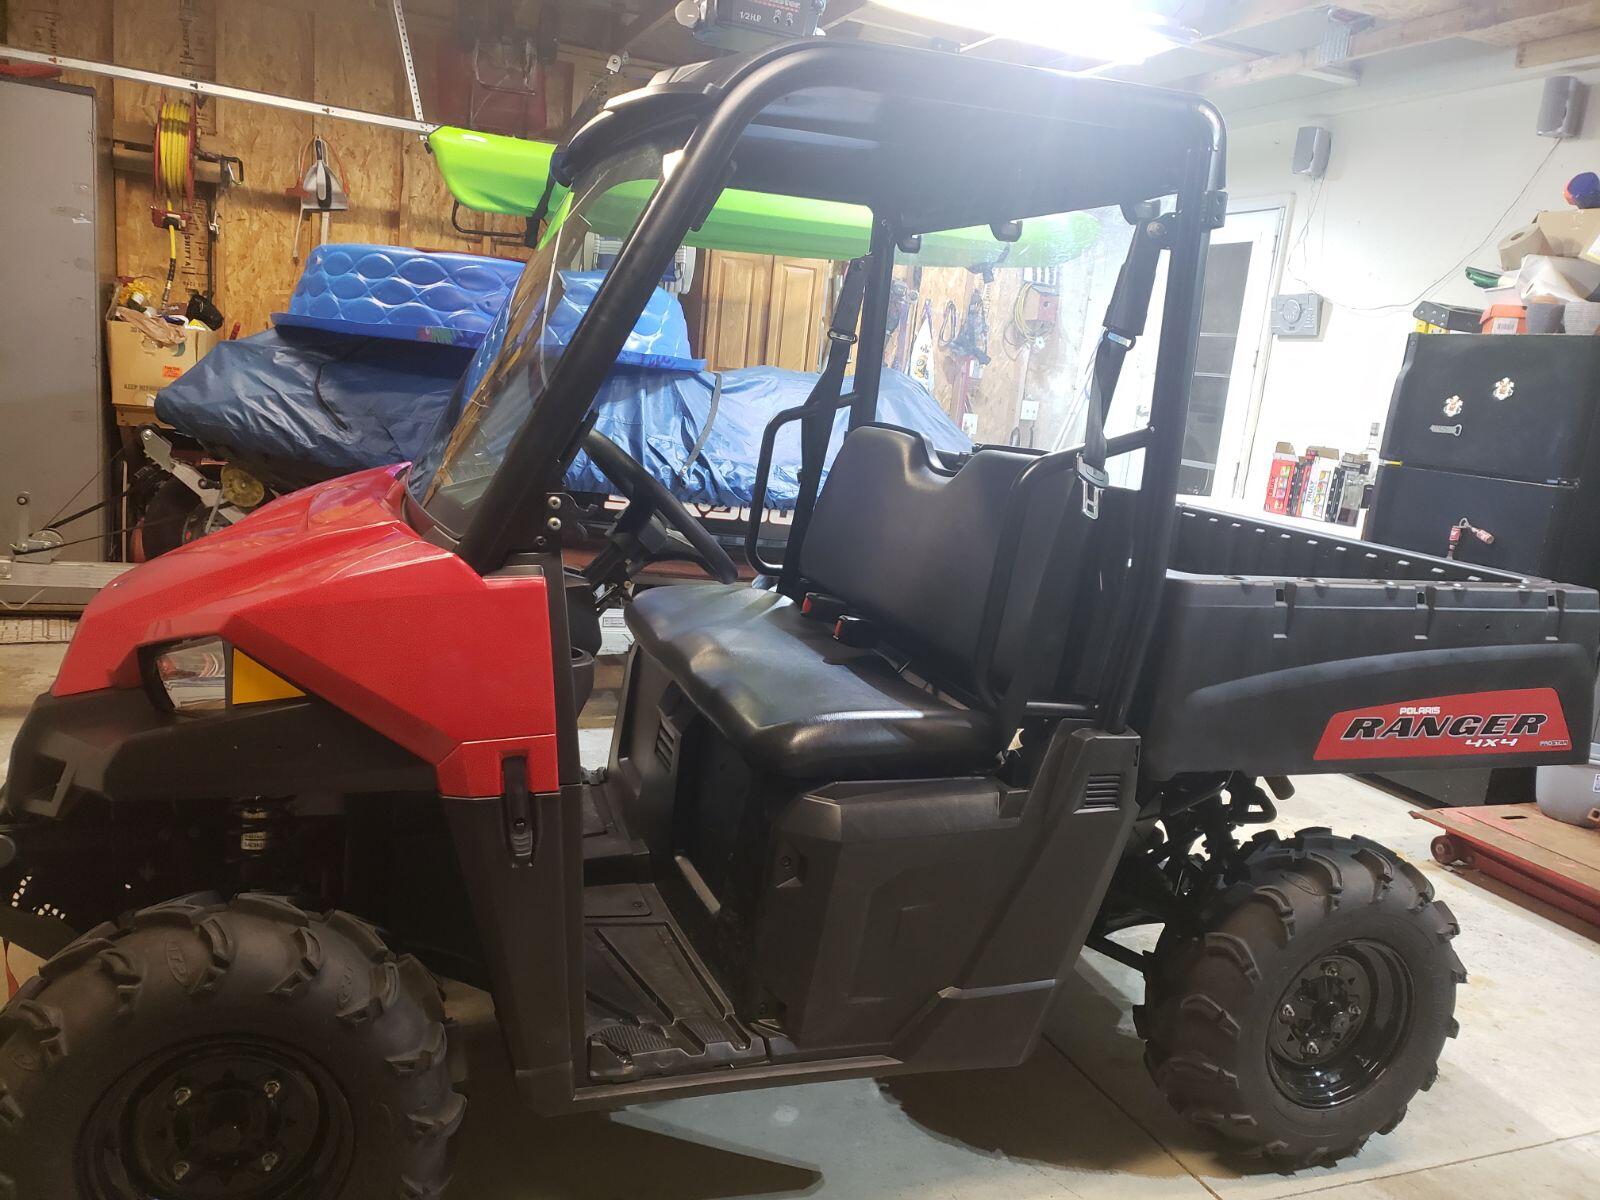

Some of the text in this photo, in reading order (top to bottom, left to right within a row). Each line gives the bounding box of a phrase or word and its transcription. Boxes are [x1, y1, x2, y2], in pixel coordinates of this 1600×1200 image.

[1307, 481, 1315, 502] TRULY
[1399, 706, 1441, 715] POLARIS
[1341, 714, 1547, 740] RANGER
